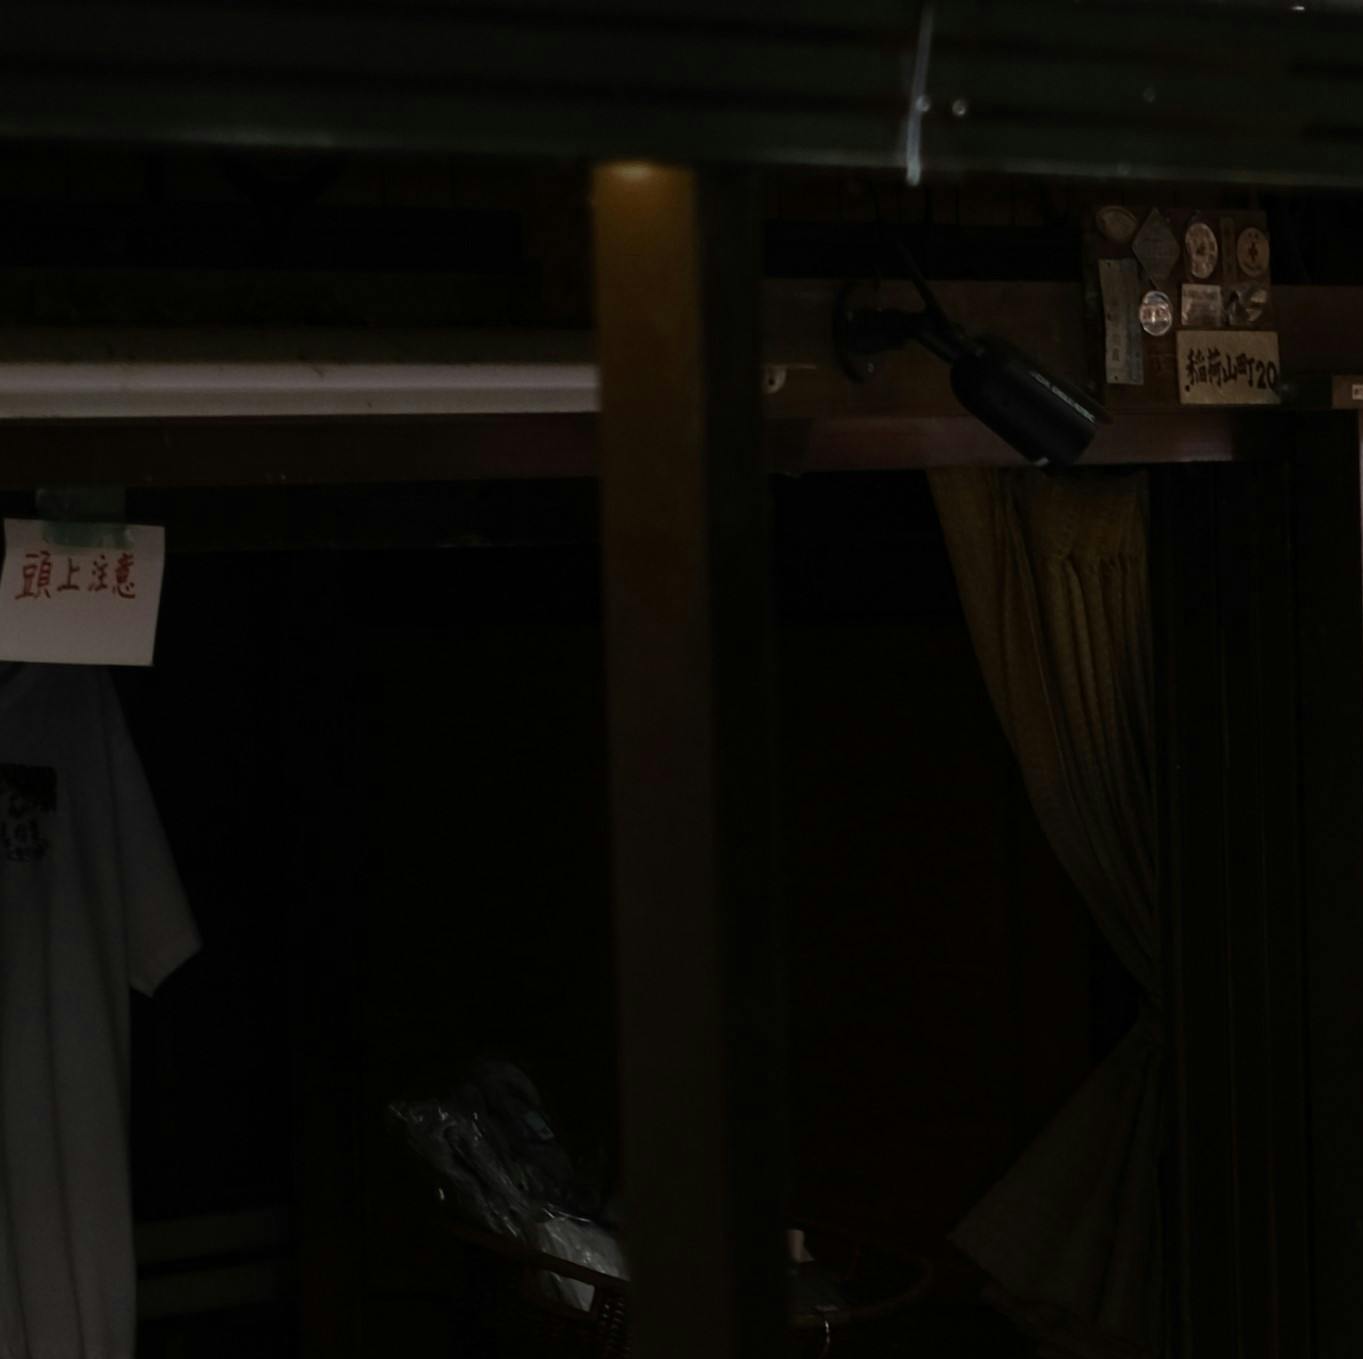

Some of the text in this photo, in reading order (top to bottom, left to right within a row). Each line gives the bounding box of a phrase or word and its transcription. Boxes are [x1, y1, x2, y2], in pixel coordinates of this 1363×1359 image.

[1186, 348, 1277, 390] 稲荷山町20
[15, 551, 136, 599] 頭上注意
